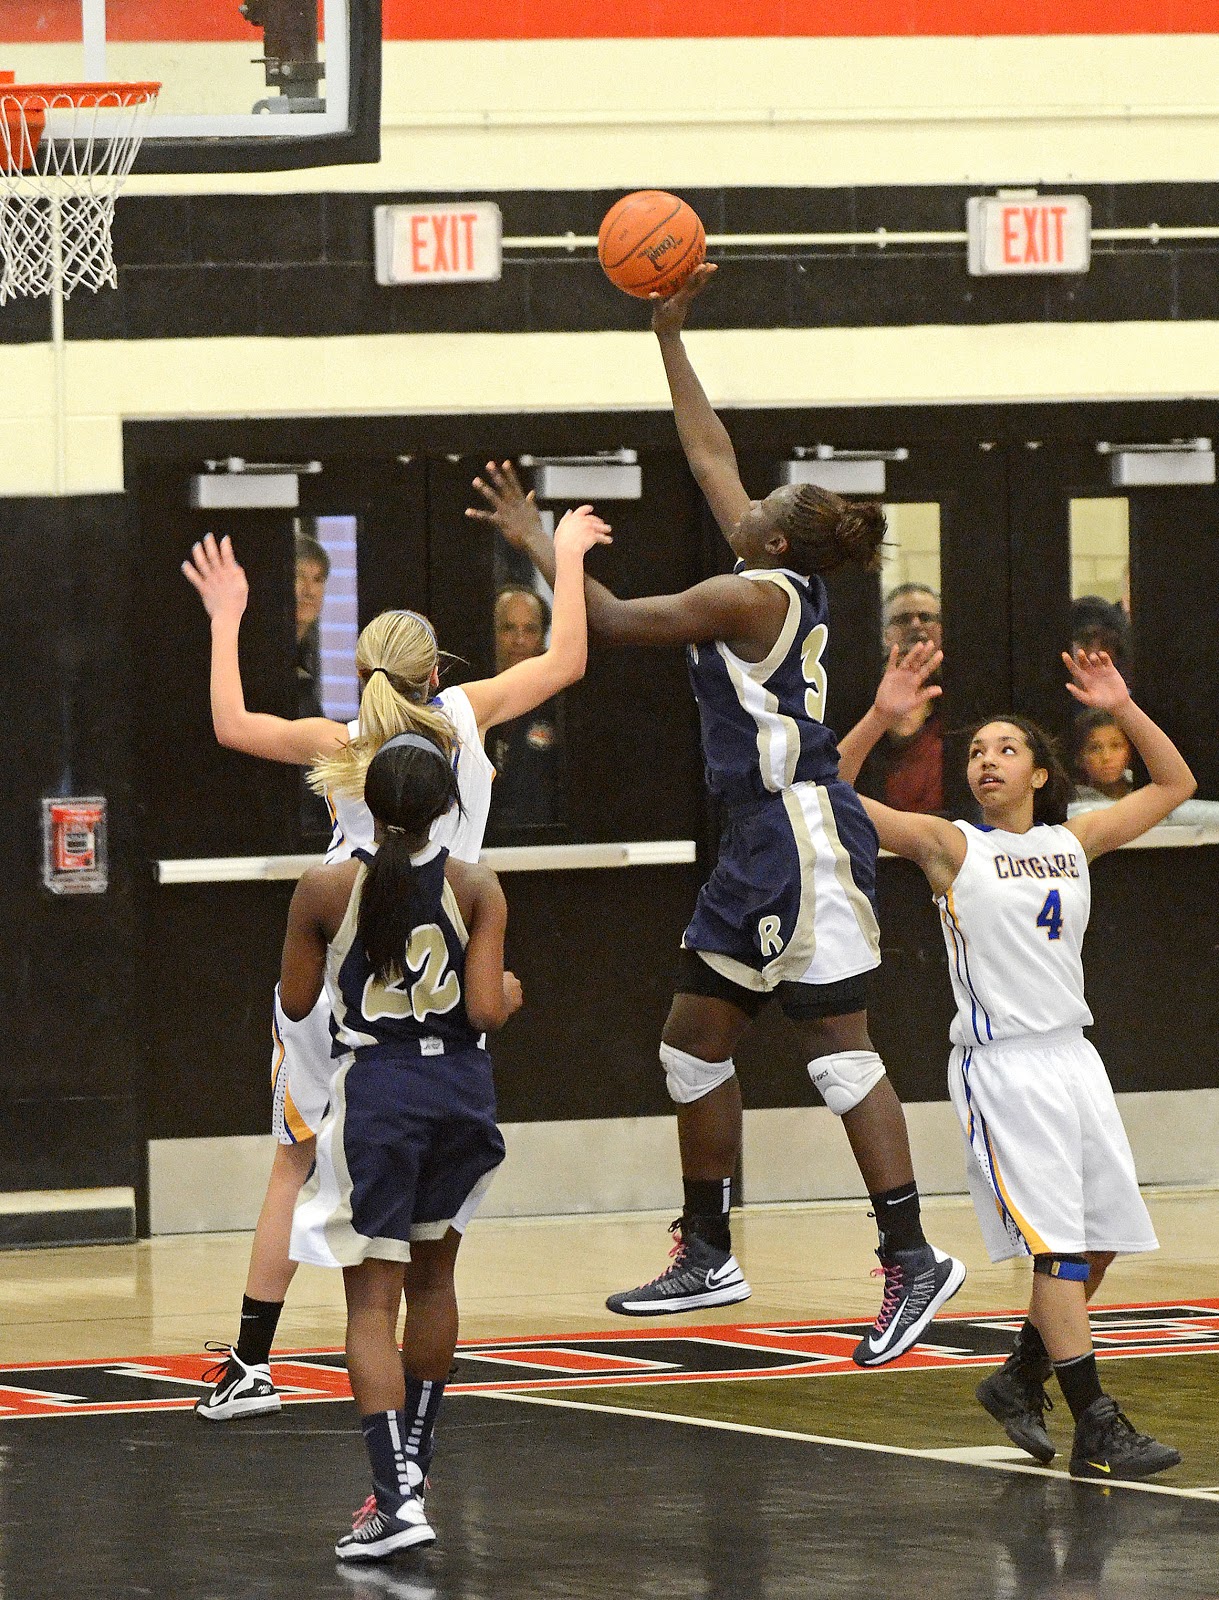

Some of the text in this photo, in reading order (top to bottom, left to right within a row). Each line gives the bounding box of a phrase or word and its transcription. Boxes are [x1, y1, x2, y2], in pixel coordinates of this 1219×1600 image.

[410, 214, 478, 273] EXIT
[1003, 206, 1067, 264] EXIT
[800, 623, 829, 724] 3
[758, 914, 784, 957] R
[1036, 888, 1063, 940] 4
